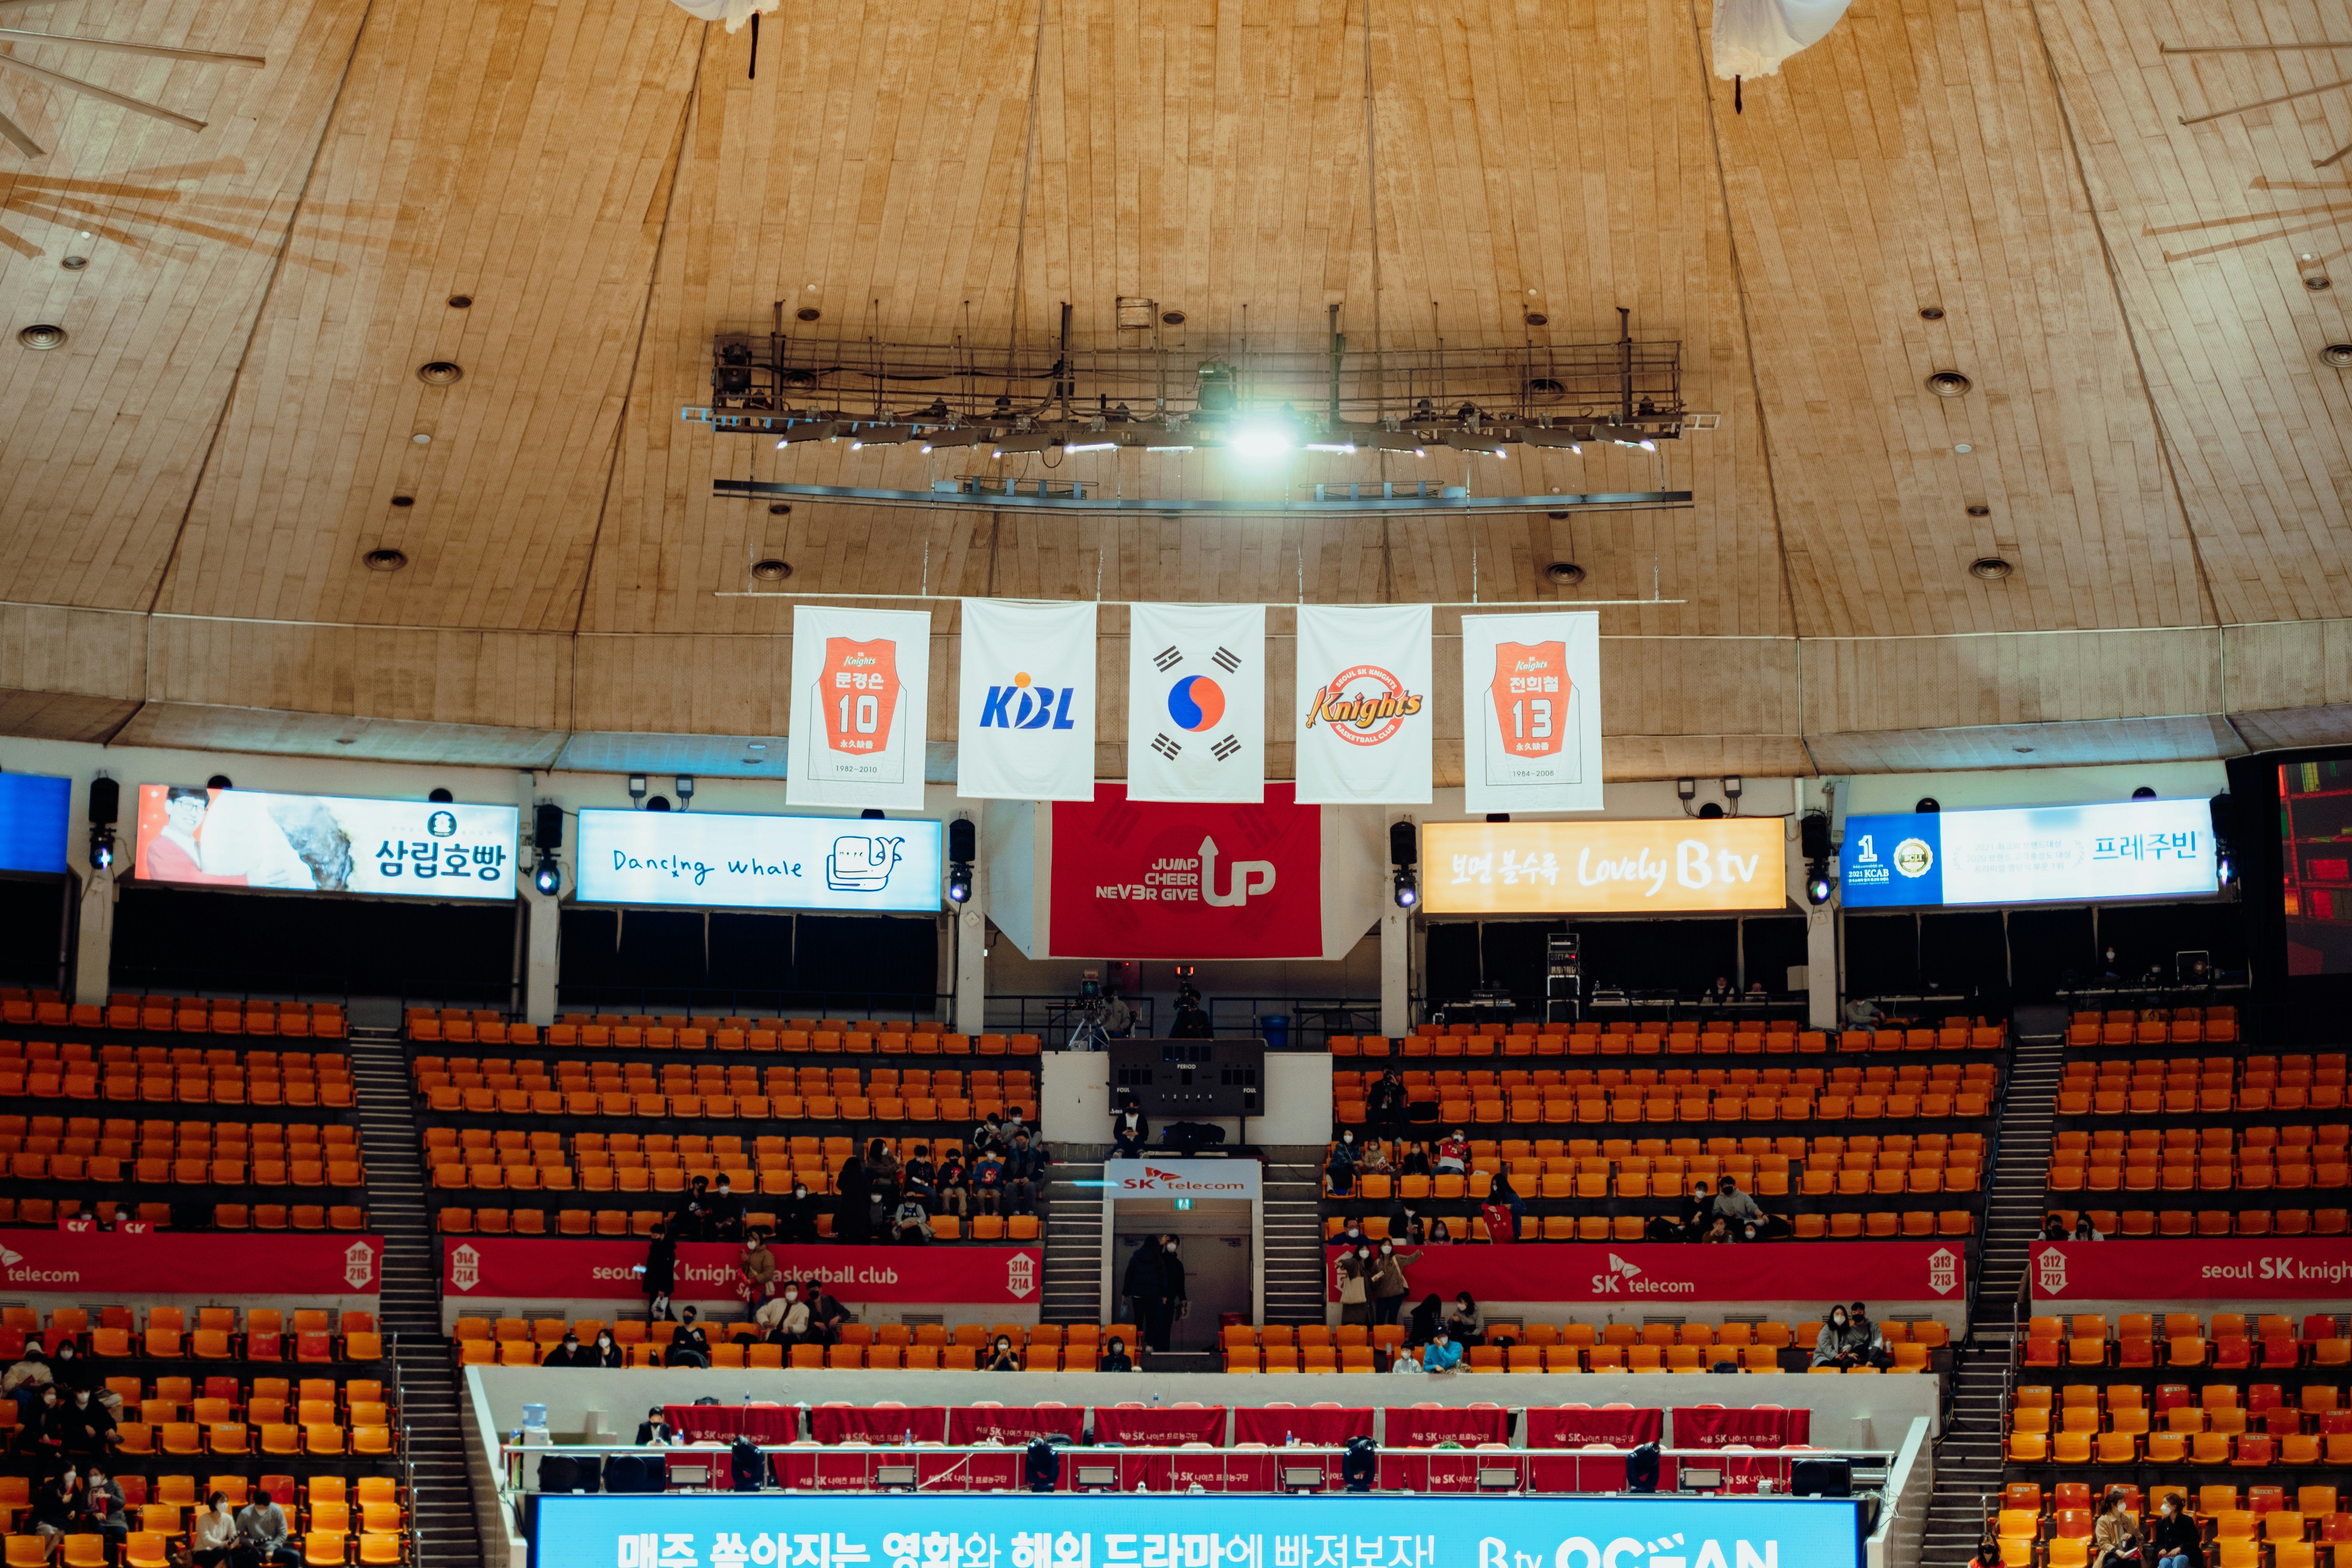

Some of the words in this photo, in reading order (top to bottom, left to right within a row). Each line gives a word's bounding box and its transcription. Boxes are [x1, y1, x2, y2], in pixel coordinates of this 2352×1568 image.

[844, 655, 876, 667] Knights
[1515, 660, 1548, 672] Knights
[836, 672, 884, 690] 문경은
[1336, 671, 1356, 688] SEOUL
[1369, 669, 1397, 690] KNIGHTS
[1510, 676, 1559, 693] 전희철
[979, 686, 1074, 730] KBL
[1305, 685, 1423, 729] Knights
[839, 694, 878, 734] 10
[1513, 699, 1552, 739] 13
[1336, 724, 1378, 743] BASKETBALL
[1378, 724, 1396, 739] CLUB
[1858, 835, 1878, 862] 1
[1997, 842, 2020, 850] 최고의
[2093, 831, 2196, 861] 프레주빈
[375, 840, 506, 881] 삼립호빵
[1989, 853, 2012, 862] 브랜드
[1152, 858, 1199, 871] JUMP
[1198, 835, 1276, 907] UP
[2033, 862, 2048, 871] 부문
[1452, 852, 1492, 885] 보면
[1578, 847, 1667, 897] Lovely
[1864, 869, 1889, 878] KCAB
[1145, 873, 1198, 886] CHEER
[1161, 888, 1198, 901] GIVE
[1123, 1179, 1156, 1189] SK
[1167, 1181, 1245, 1190] telecom
[349, 1249, 368, 1262] 315
[456, 1252, 474, 1265] 314
[2043, 1255, 2061, 1268] 312
[1011, 1260, 1030, 1273] 314
[1933, 1256, 1951, 1269] 313
[2202, 1261, 2252, 1279] seoul
[2259, 1258, 2294, 1279] SK
[7, 1267, 80, 1283] telecom
[348, 1268, 367, 1281] 215
[456, 1270, 475, 1283] 214
[772, 1266, 855, 1284] asketball
[859, 1267, 898, 1285] club
[1933, 1273, 1951, 1287] 213
[2044, 1273, 2062, 1286] 212
[1011, 1277, 1030, 1290] 214
[1592, 1275, 1620, 1294] SK
[1629, 1278, 1695, 1293] telecom
[704, 1430, 717, 1440] SK
[853, 1432, 865, 1441] SK
[989, 1426, 1001, 1436] SK
[1133, 1432, 1145, 1441] SK
[1425, 1433, 1438, 1441] SK
[1568, 1433, 1581, 1442] SK
[1715, 1434, 1727, 1443] SK
[942, 1473, 953, 1482] SK
[1180, 1472, 1193, 1481] SK
[1194, 1473, 1214, 1481] 나이츠
[1443, 1474, 1455, 1484] SK
[1736, 1475, 1748, 1485] SK
[618, 1533, 697, 1568] 매주
[882, 1531, 1002, 1568] 영화와
[1011, 1531, 1091, 1568] 해외
[1103, 1533, 1263, 1568] 드라마에
